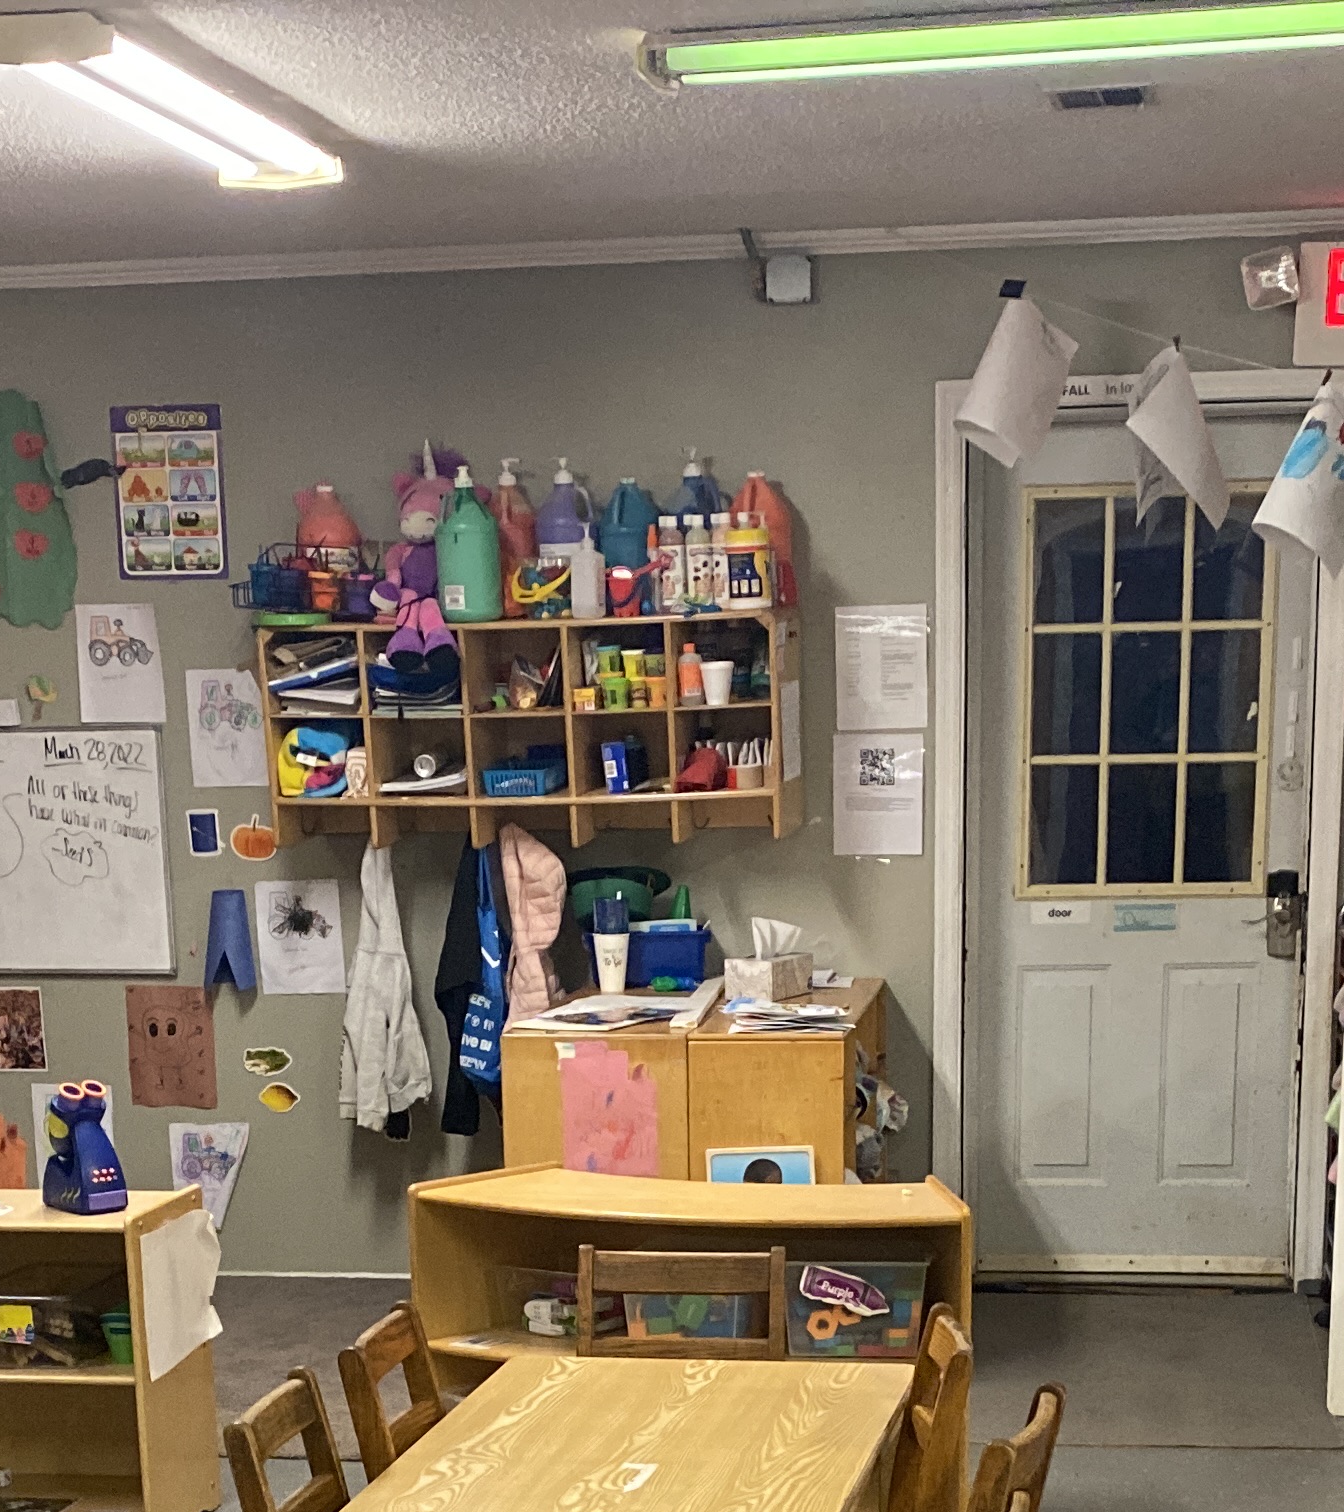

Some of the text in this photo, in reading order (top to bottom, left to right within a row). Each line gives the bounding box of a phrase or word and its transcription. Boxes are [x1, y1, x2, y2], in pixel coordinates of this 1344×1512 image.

[126, 410, 207, 430] Opposites
[1047, 907, 1073, 918] door
[820, 1280, 854, 1299] Purple
